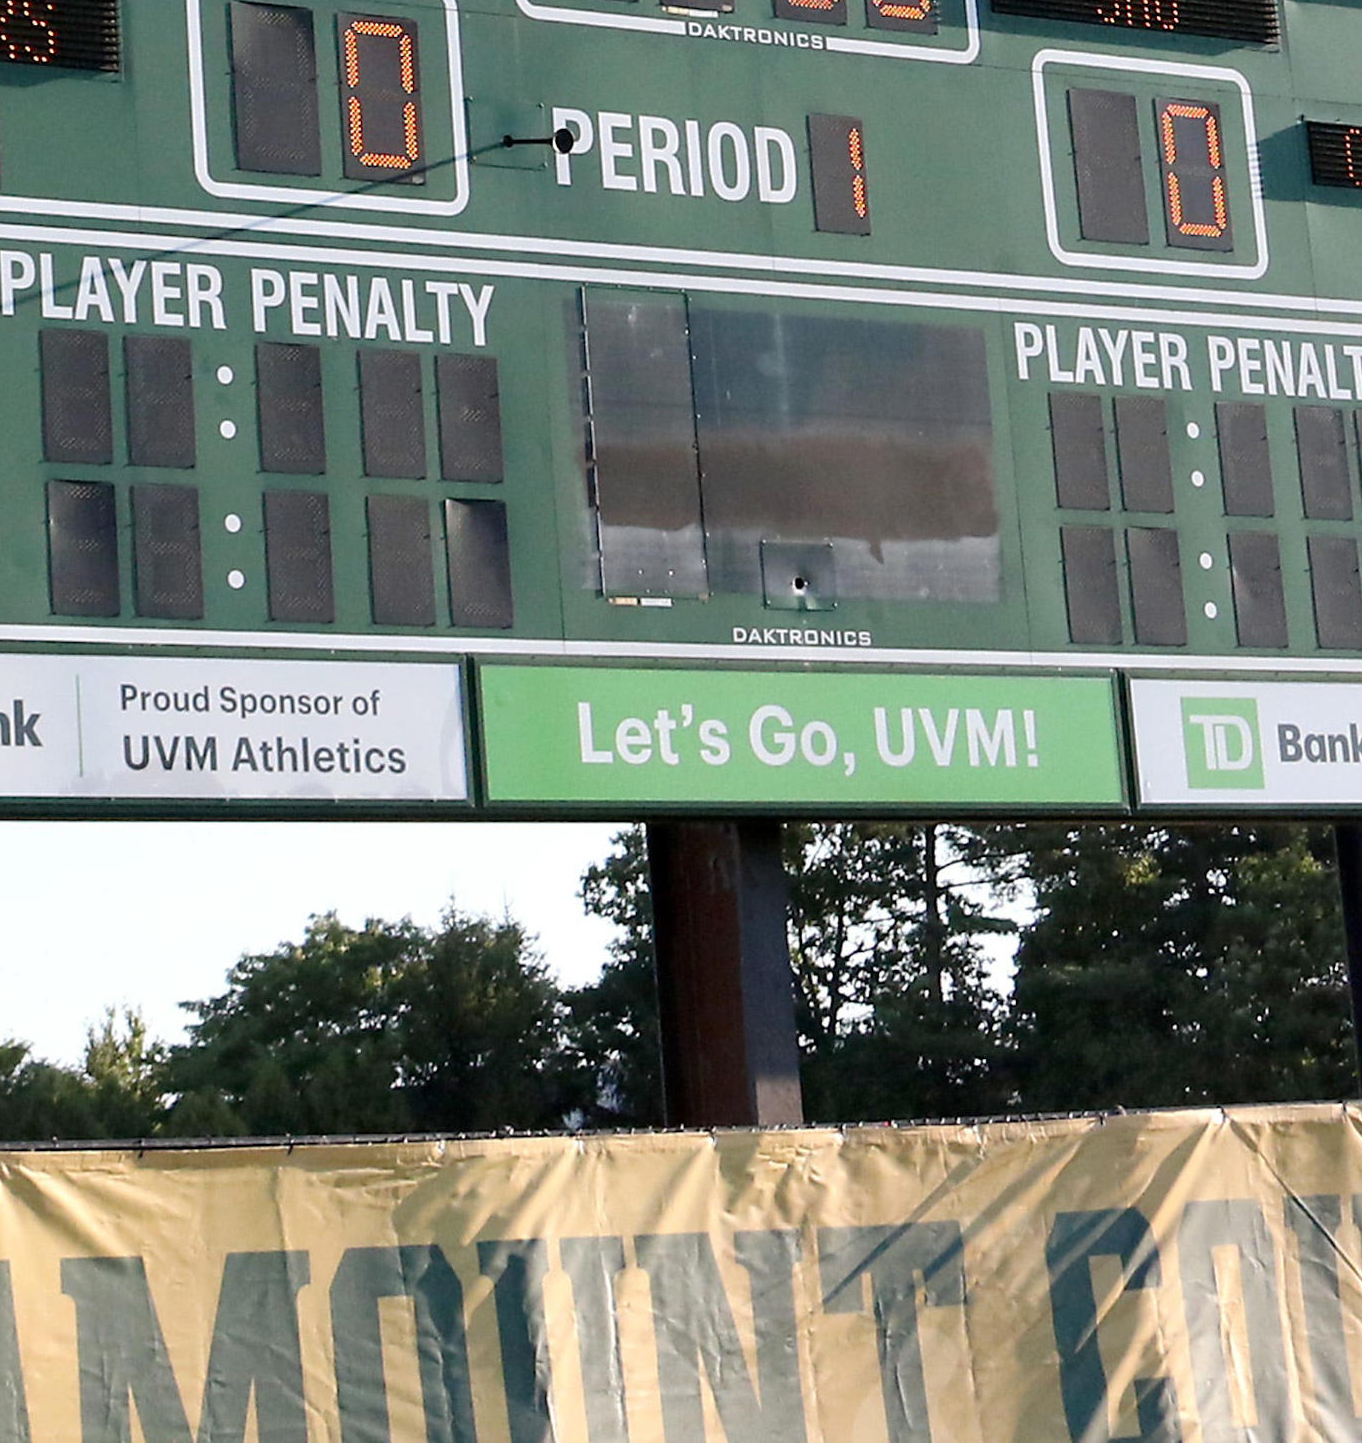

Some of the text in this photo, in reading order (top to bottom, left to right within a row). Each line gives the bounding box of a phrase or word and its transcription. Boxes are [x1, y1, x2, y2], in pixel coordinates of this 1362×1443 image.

[688, 21, 824, 51] DAKTRONICS
[343, 20, 420, 169] 0
[551, 106, 798, 204] PERIOD
[849, 127, 868, 218] 1
[1160, 103, 1228, 238] 0
[251, 268, 496, 348] PENALTY
[1013, 322, 1193, 391] PLAYER
[733, 627, 872, 647] DAKTRONICS
[120, 683, 381, 720] Proud Sponsor of
[123, 735, 408, 775] UVM Athletics
[748, 704, 857, 777] Go,
[872, 707, 1039, 769] UVM!
[1189, 714, 1253, 771] TD
